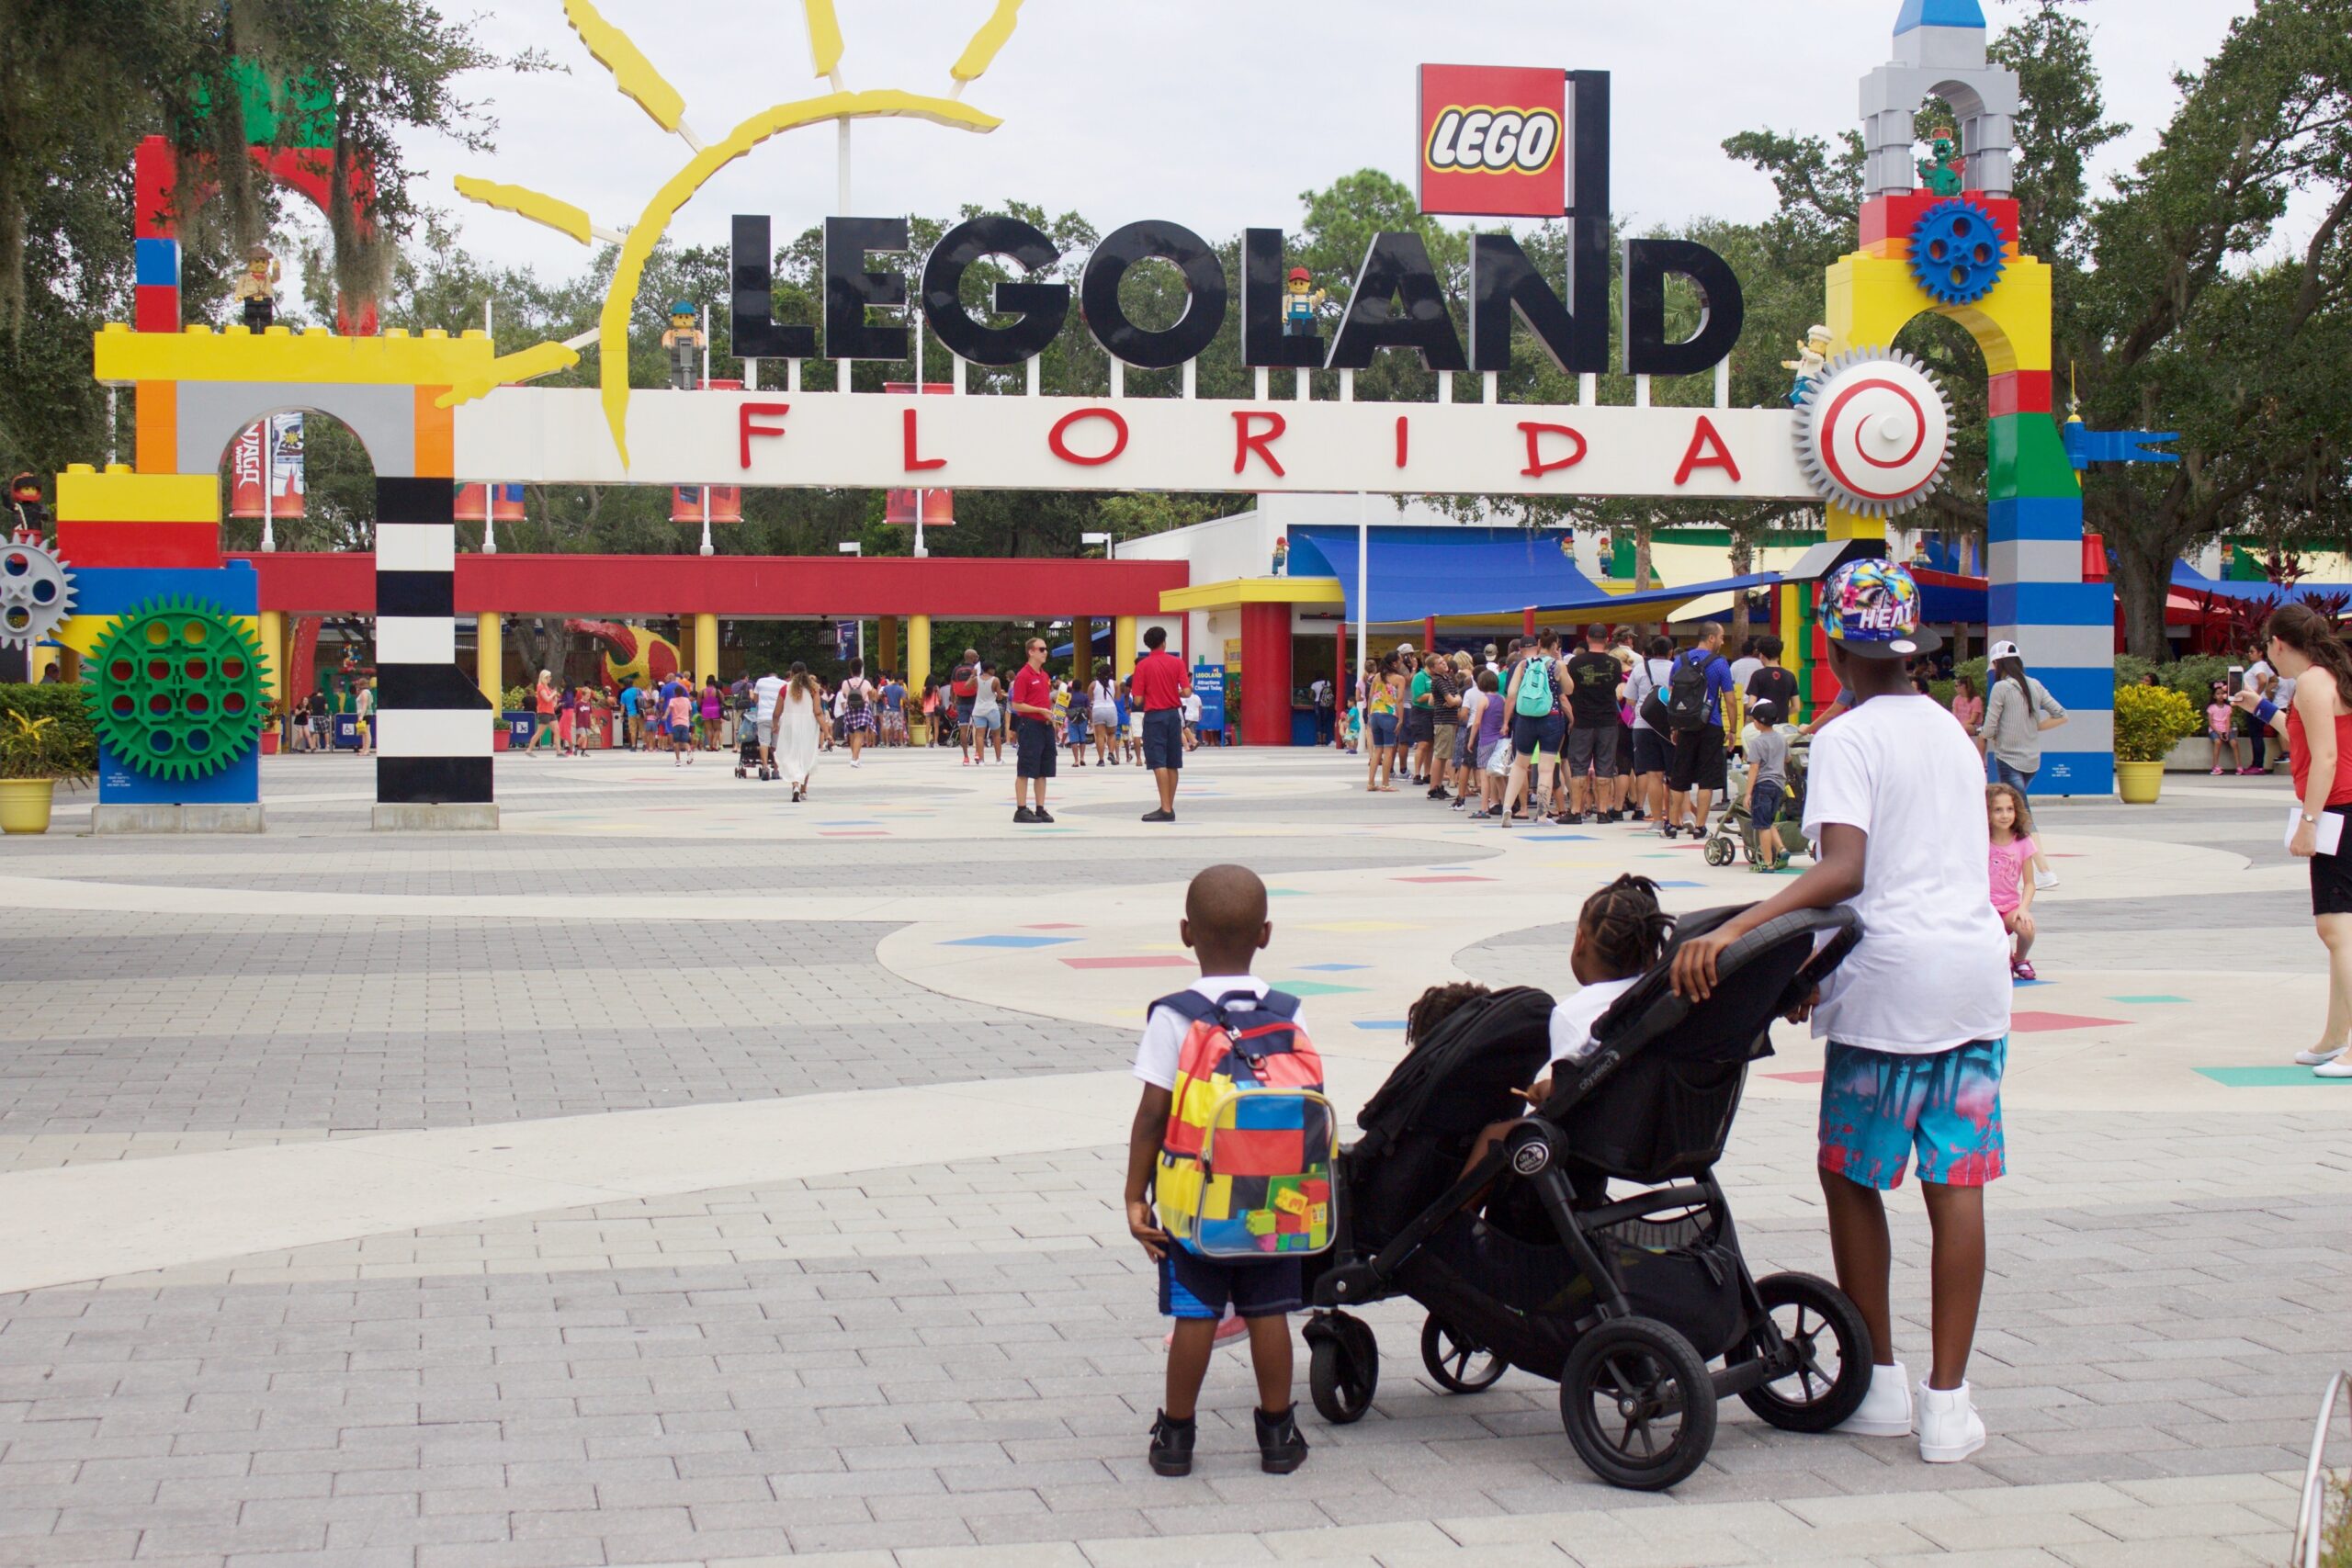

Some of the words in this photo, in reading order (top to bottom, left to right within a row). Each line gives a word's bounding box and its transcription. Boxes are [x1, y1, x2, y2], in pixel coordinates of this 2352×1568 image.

[1429, 108, 1559, 172] LEGO
[731, 213, 1745, 375] LEGOLAND
[235, 446, 243, 475] World
[739, 402, 1741, 486] FLORIDA
[1859, 593, 1915, 629] HEAT
